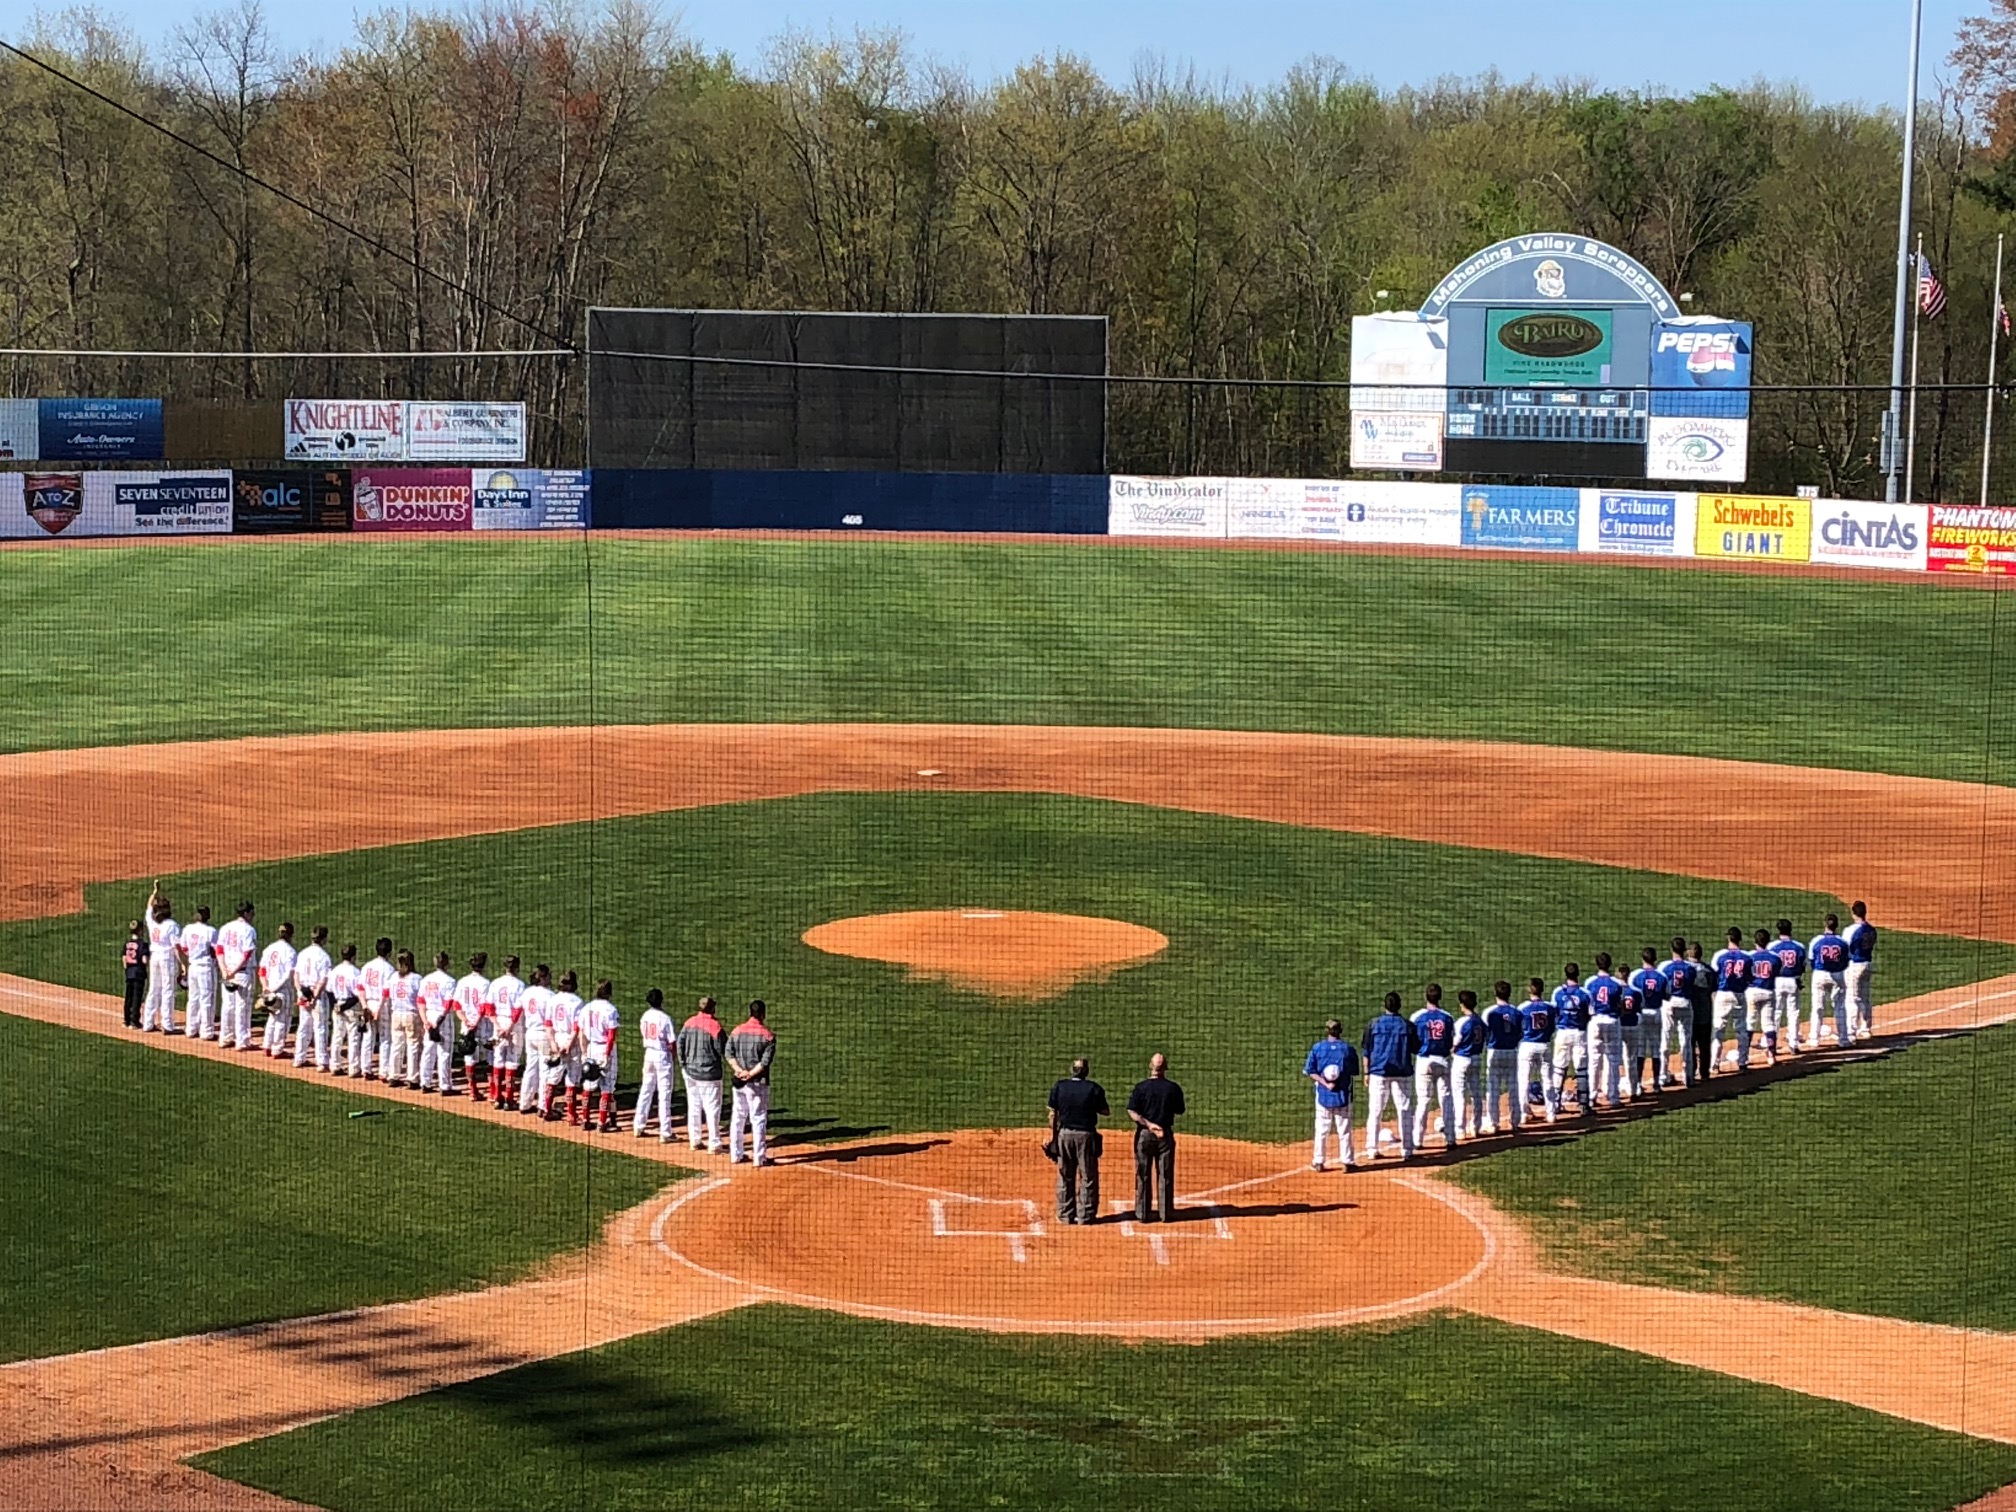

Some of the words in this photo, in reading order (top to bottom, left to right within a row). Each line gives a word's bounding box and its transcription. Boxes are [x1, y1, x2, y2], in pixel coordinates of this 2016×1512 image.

[1432, 245, 1513, 307] Mahoning
[1518, 236, 1577, 254] Valley
[1583, 241, 1669, 312] Scrappers
[288, 401, 401, 436] KNIGHTLINE
[32, 490, 47, 507] A
[46, 492, 62, 502] TO
[62, 489, 75, 507] Z
[119, 488, 158, 500] SEVEN
[159, 487, 227, 500] SEVENTEEN
[262, 482, 301, 507] alc
[385, 486, 470, 503] DUNKIN'
[477, 490, 507, 500] Days
[508, 490, 529, 499] Inn
[1115, 480, 1144, 497] The
[1147, 481, 1224, 497] Vindicator
[160, 503, 195, 515] credit
[385, 503, 467, 521] DONUTS
[1604, 497, 1670, 516] Tribune
[1714, 499, 1794, 528] Schwebel's
[1488, 507, 1577, 527] FARMERS
[1600, 518, 1674, 538] Chronicle
[1931, 527, 2016, 547] FIREWORKS
[1723, 531, 1784, 554] GIANT
[1597, 986, 1608, 1005] 4
